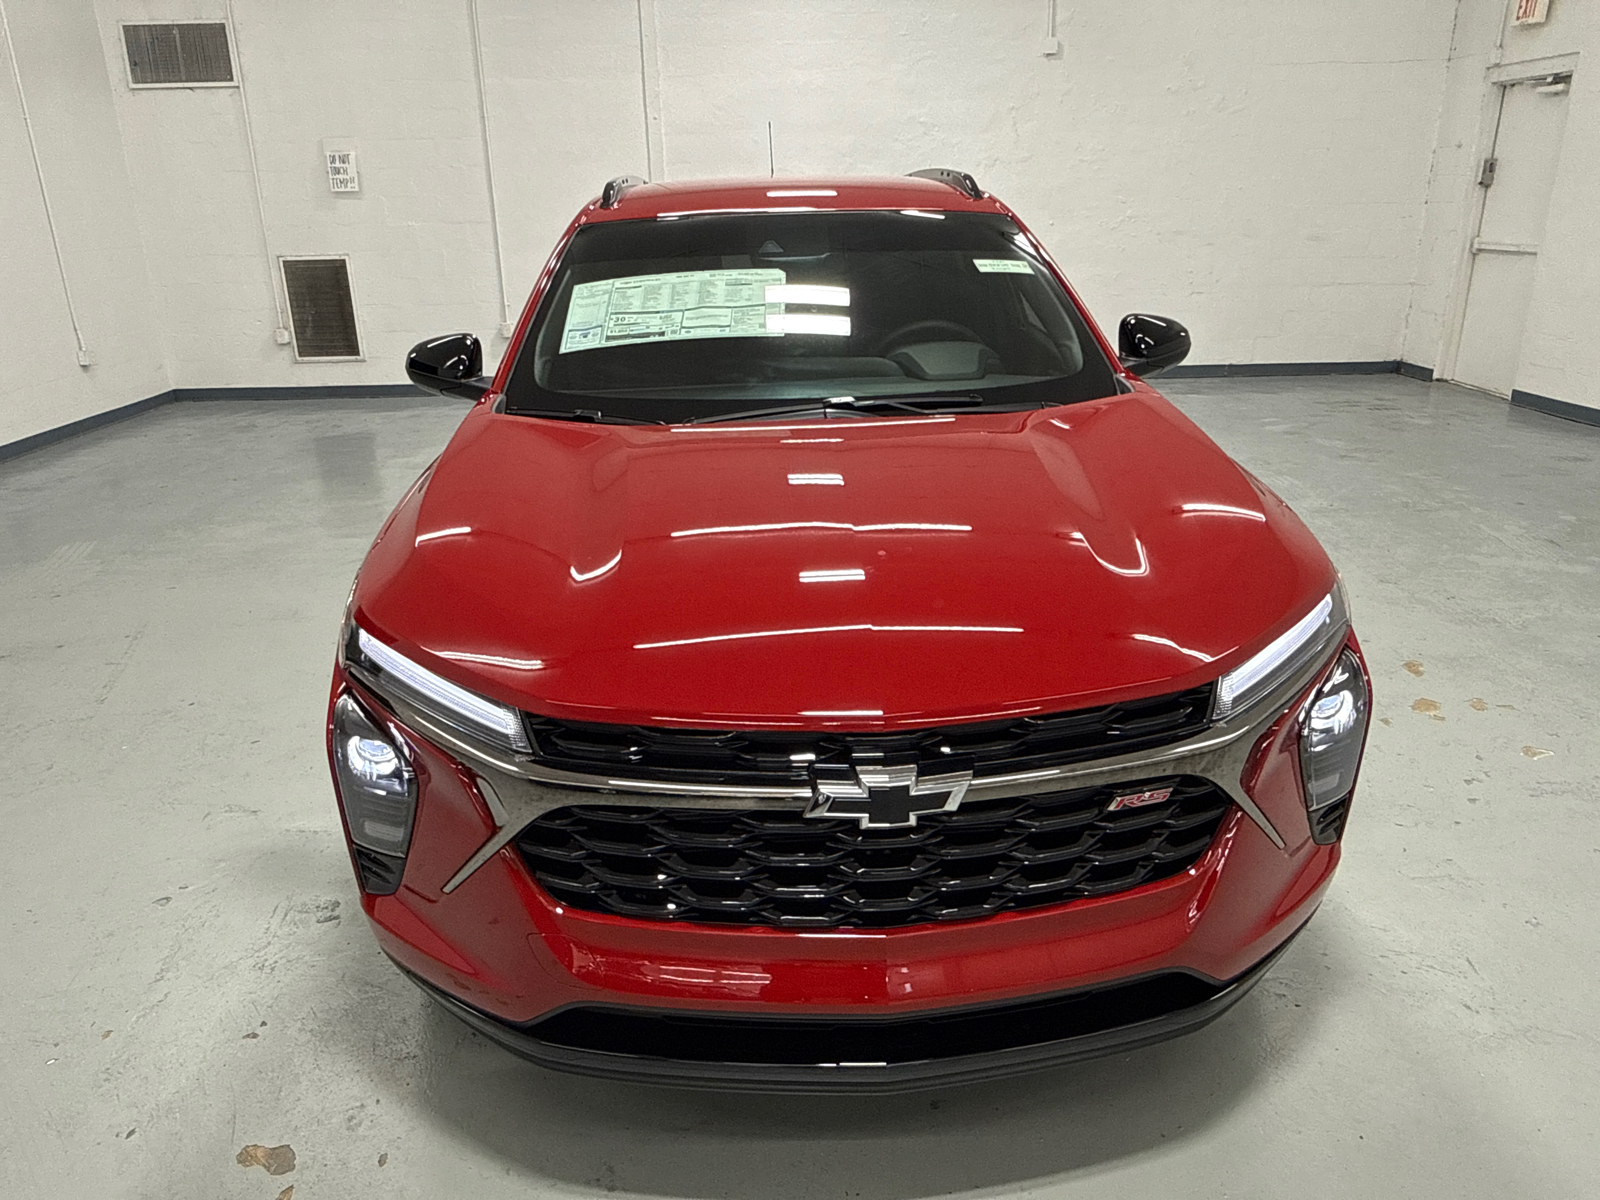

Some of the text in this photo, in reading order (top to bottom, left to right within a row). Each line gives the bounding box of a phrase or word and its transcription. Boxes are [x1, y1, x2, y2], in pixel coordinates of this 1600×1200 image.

[329, 153, 351, 165] DO NOT
[330, 166, 348, 177] TOUCH
[1107, 787, 1174, 811] RS
